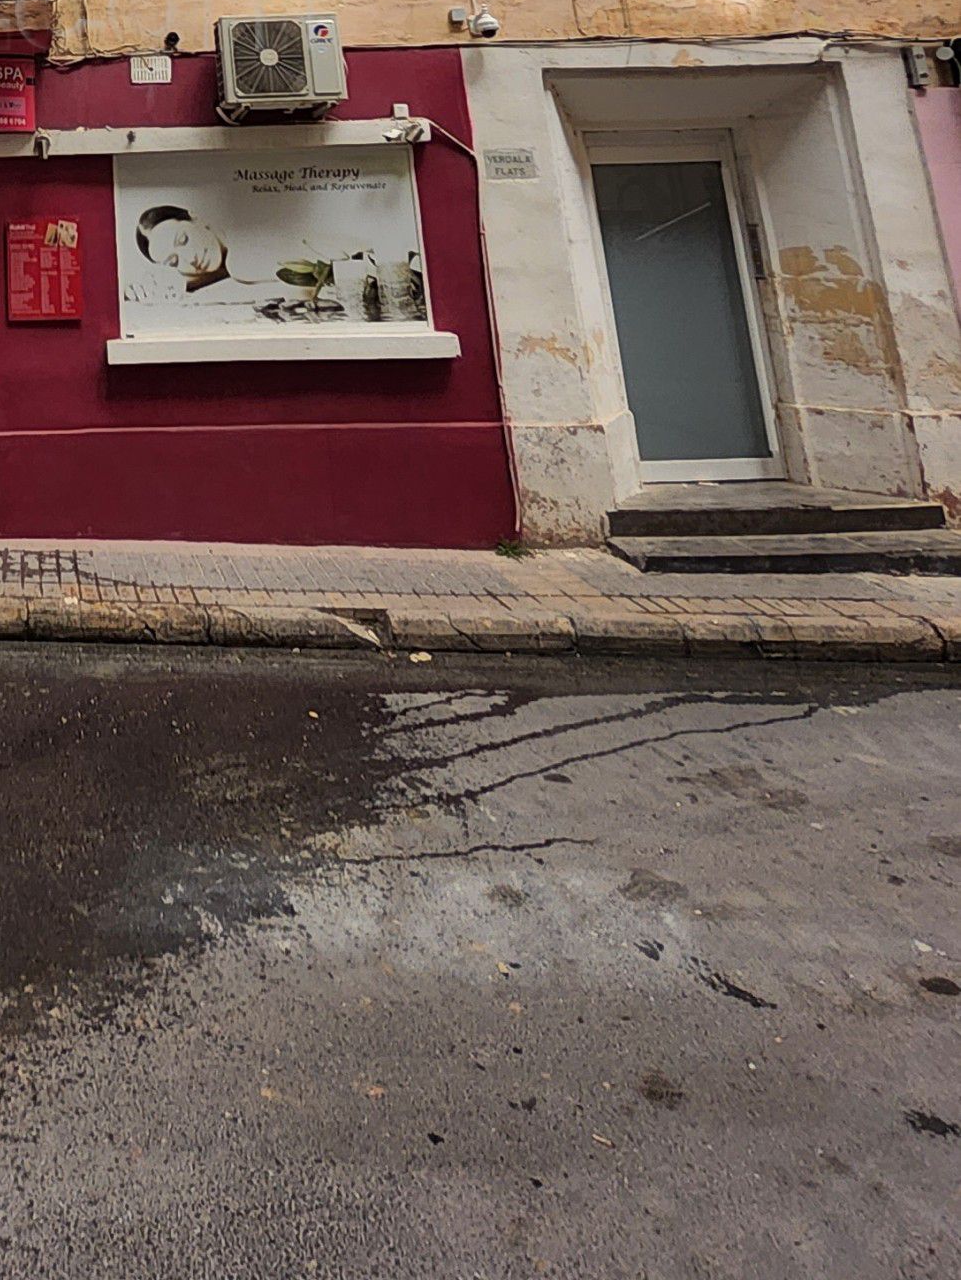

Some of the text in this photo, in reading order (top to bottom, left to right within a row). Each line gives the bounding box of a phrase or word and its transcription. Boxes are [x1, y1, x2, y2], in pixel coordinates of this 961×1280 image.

[233, 164, 361, 184] Massage Therapy
[494, 167, 526, 176] FLATS
[310, 183, 328, 192] and
